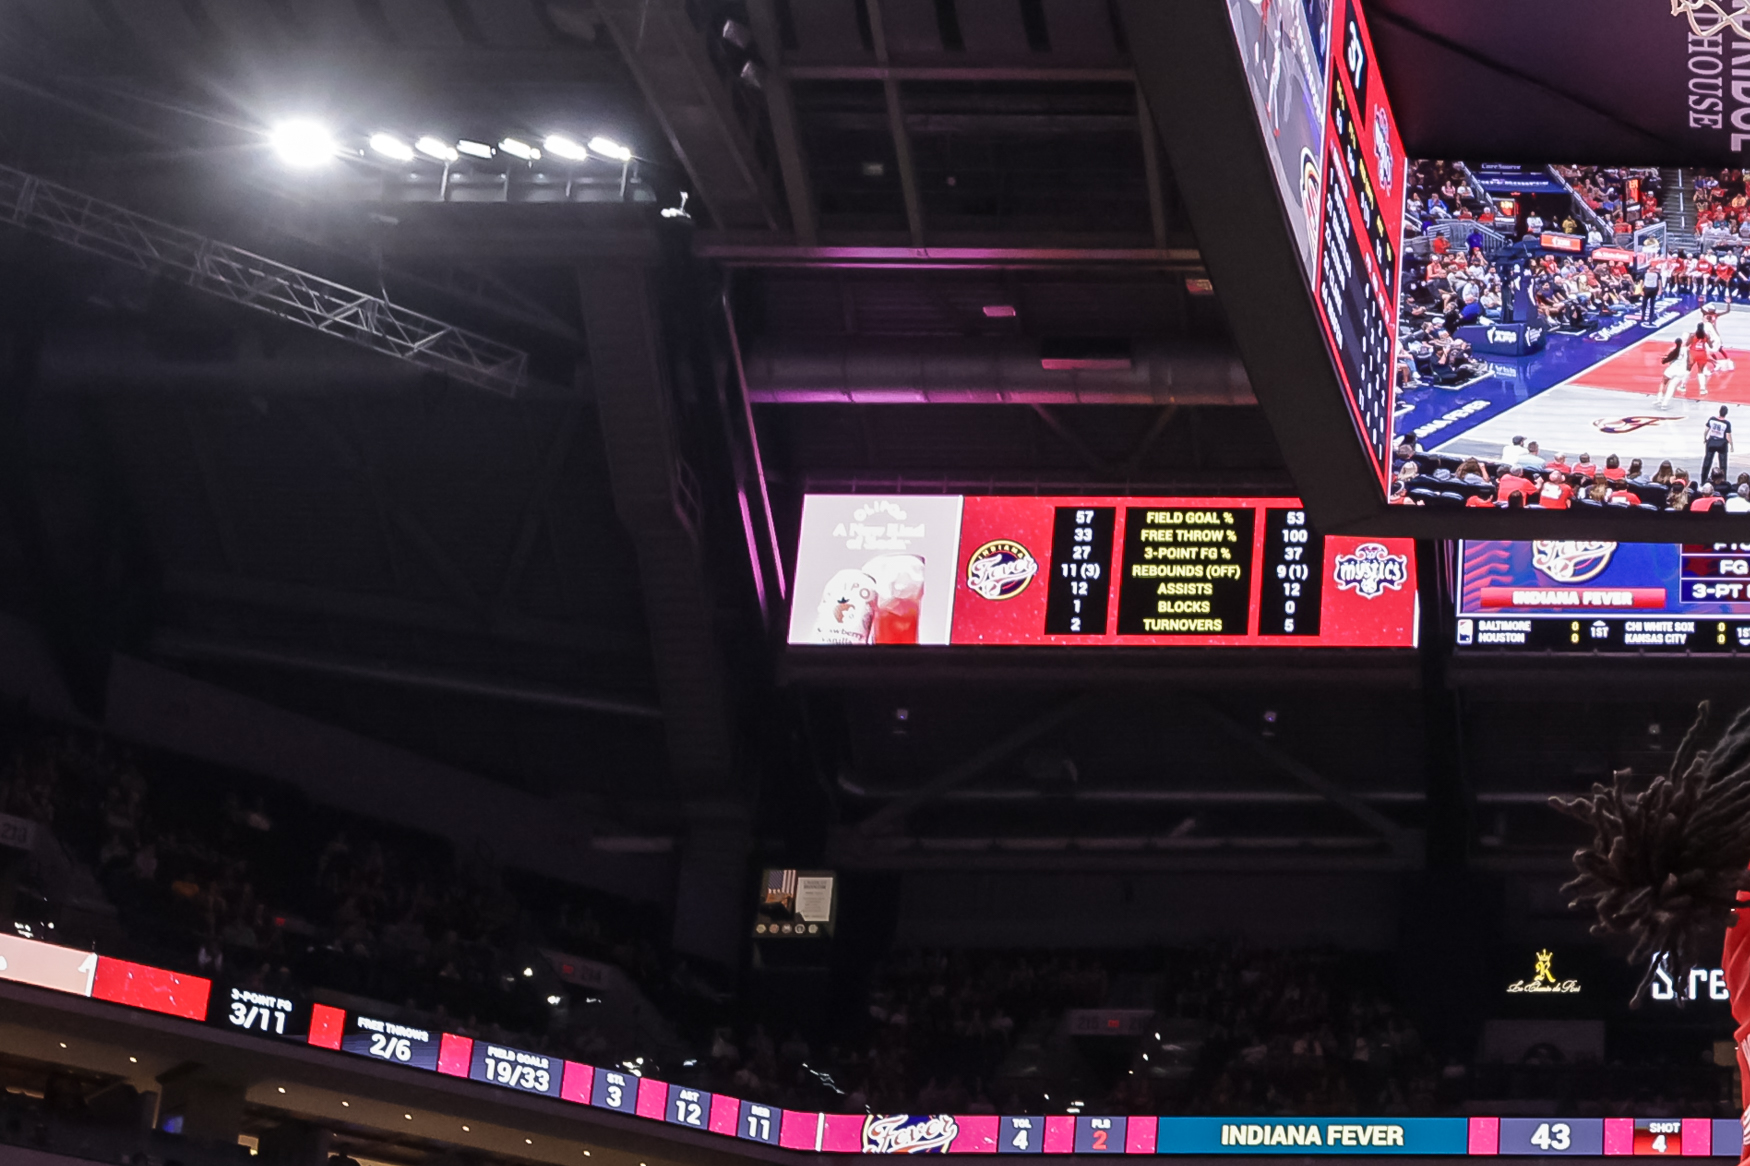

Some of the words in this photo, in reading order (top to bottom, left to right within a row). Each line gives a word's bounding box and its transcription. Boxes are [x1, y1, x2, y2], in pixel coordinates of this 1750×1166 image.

[1076, 510, 1094, 524] 57
[1146, 512, 1183, 524] FIELD
[1185, 512, 1220, 524] GOAL
[1223, 513, 1234, 524] %
[1287, 511, 1305, 525] 53
[1074, 528, 1092, 542] 33
[1141, 530, 1173, 542] FREE
[1176, 530, 1224, 542] THROW
[1226, 530, 1237, 542] %
[1282, 529, 1308, 543] 100
[1073, 545, 1091, 560] 27
[1144, 547, 1198, 560] 3-POINT
[1200, 548, 1218, 560] FG
[1220, 548, 1231, 560] %
[1284, 547, 1303, 561] 37
[1061, 563, 1077, 577] 11
[1080, 563, 1100, 579] (3)
[1132, 565, 1204, 577] REBOUNDS
[1206, 565, 1241, 580] (OFF)
[1277, 565, 1287, 579] 9
[1289, 565, 1308, 580] (1)
[1720, 560, 1749, 575] FG
[1071, 582, 1088, 596] 12
[1157, 583, 1213, 595] ASSISTS
[1283, 583, 1300, 596] 12
[1692, 585, 1743, 599] 3-PT
[1512, 591, 1579, 606] INDIANA
[1583, 592, 1633, 606] FEVER
[1073, 599, 1082, 613] 1
[1157, 601, 1210, 613] BLOCKS
[1285, 601, 1295, 614] 0
[1070, 617, 1081, 631] 2
[1143, 618, 1222, 631] TURNOVERS
[1284, 619, 1294, 632] 5
[1478, 620, 1531, 632] BALTIMORE
[1625, 621, 1641, 632] CHI
[1642, 621, 1672, 632] WHITE
[1674, 621, 1695, 633] SOX
[1478, 632, 1525, 644] HOUSTON
[1590, 625, 1609, 638] 1ST
[1625, 632, 1663, 644] KANSAS
[1664, 632, 1688, 644] CITY
[229, 1002, 286, 1035] 3/11
[369, 1034, 411, 1061] 2/6
[484, 1057, 550, 1092] 19/33
[606, 1087, 622, 1108] 3
[675, 1101, 701, 1125] 12
[747, 1116, 772, 1140] 11
[1012, 1119, 1031, 1129] TOL
[1649, 1122, 1680, 1134] SHOT
[1012, 1129, 1029, 1151] 4
[1092, 1130, 1108, 1151] 2
[1221, 1125, 1322, 1146] INDIANA
[1327, 1126, 1404, 1146] FEVER
[1530, 1123, 1571, 1150] 43
[1652, 1134, 1666, 1153] 4
